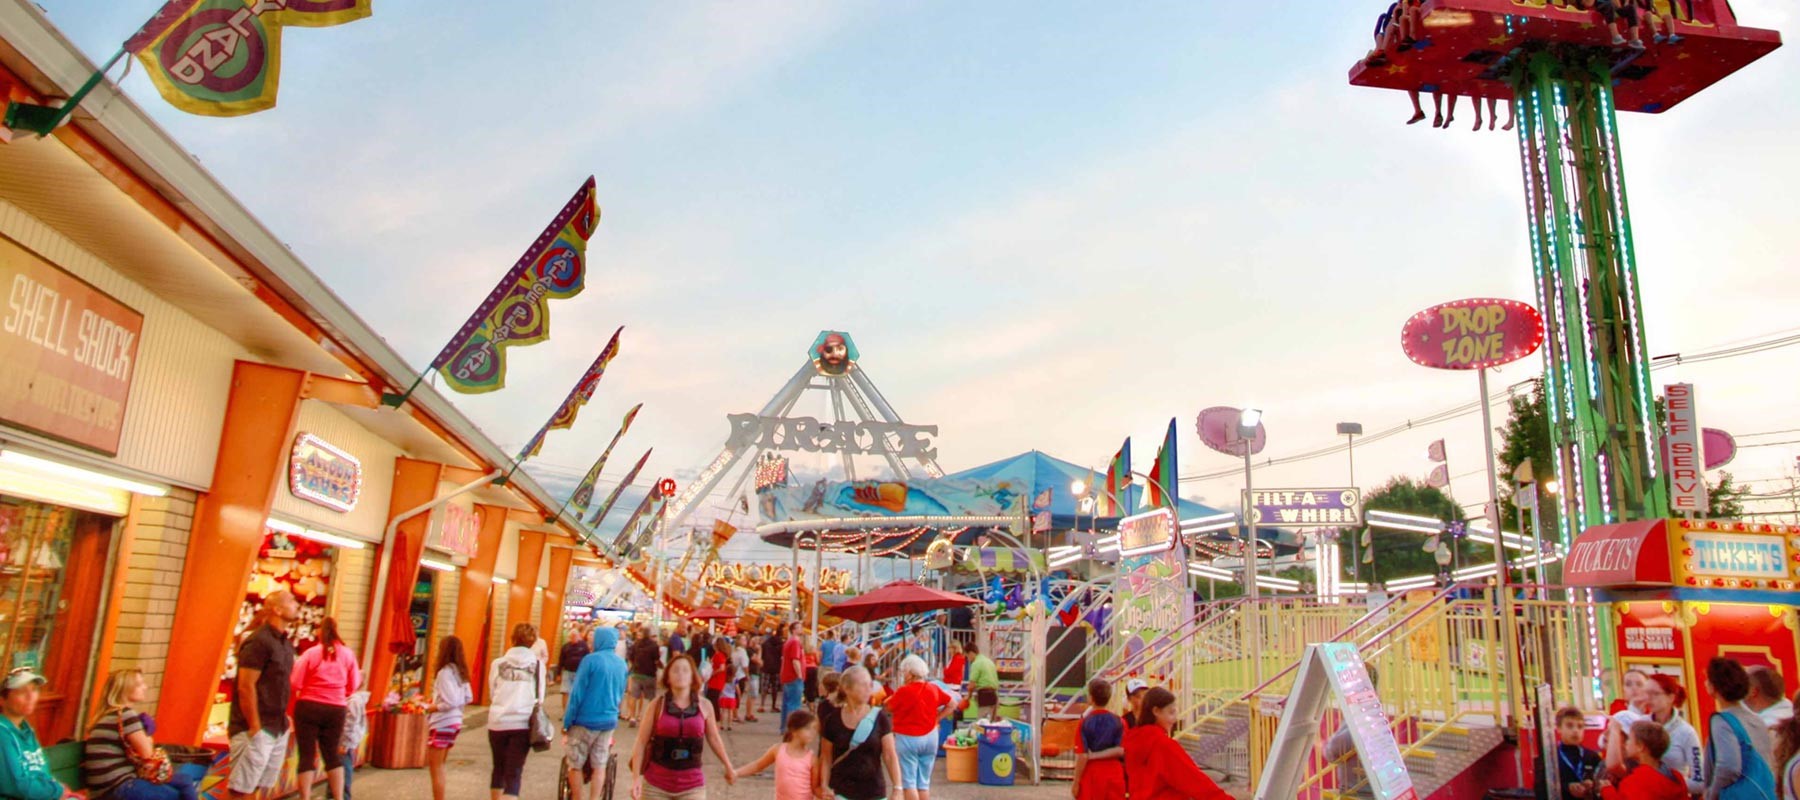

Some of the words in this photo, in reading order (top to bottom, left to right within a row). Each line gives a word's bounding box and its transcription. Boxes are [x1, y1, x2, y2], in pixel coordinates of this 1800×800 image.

[524, 248, 575, 305] PALACE
[4, 273, 72, 356] SHELL
[73, 308, 136, 382] SHOCK
[455, 305, 528, 380] PLAYLAND
[1439, 305, 1506, 336] DROP
[1441, 332, 1504, 365] ZONE
[1667, 385, 1689, 435] SELF
[725, 412, 939, 460] PIRATE
[1671, 442, 1697, 507] SERVE
[1280, 508, 1355, 522] WHIRL
[1570, 536, 1638, 574] TICKETS
[1694, 539, 1783, 572] TICKETS
